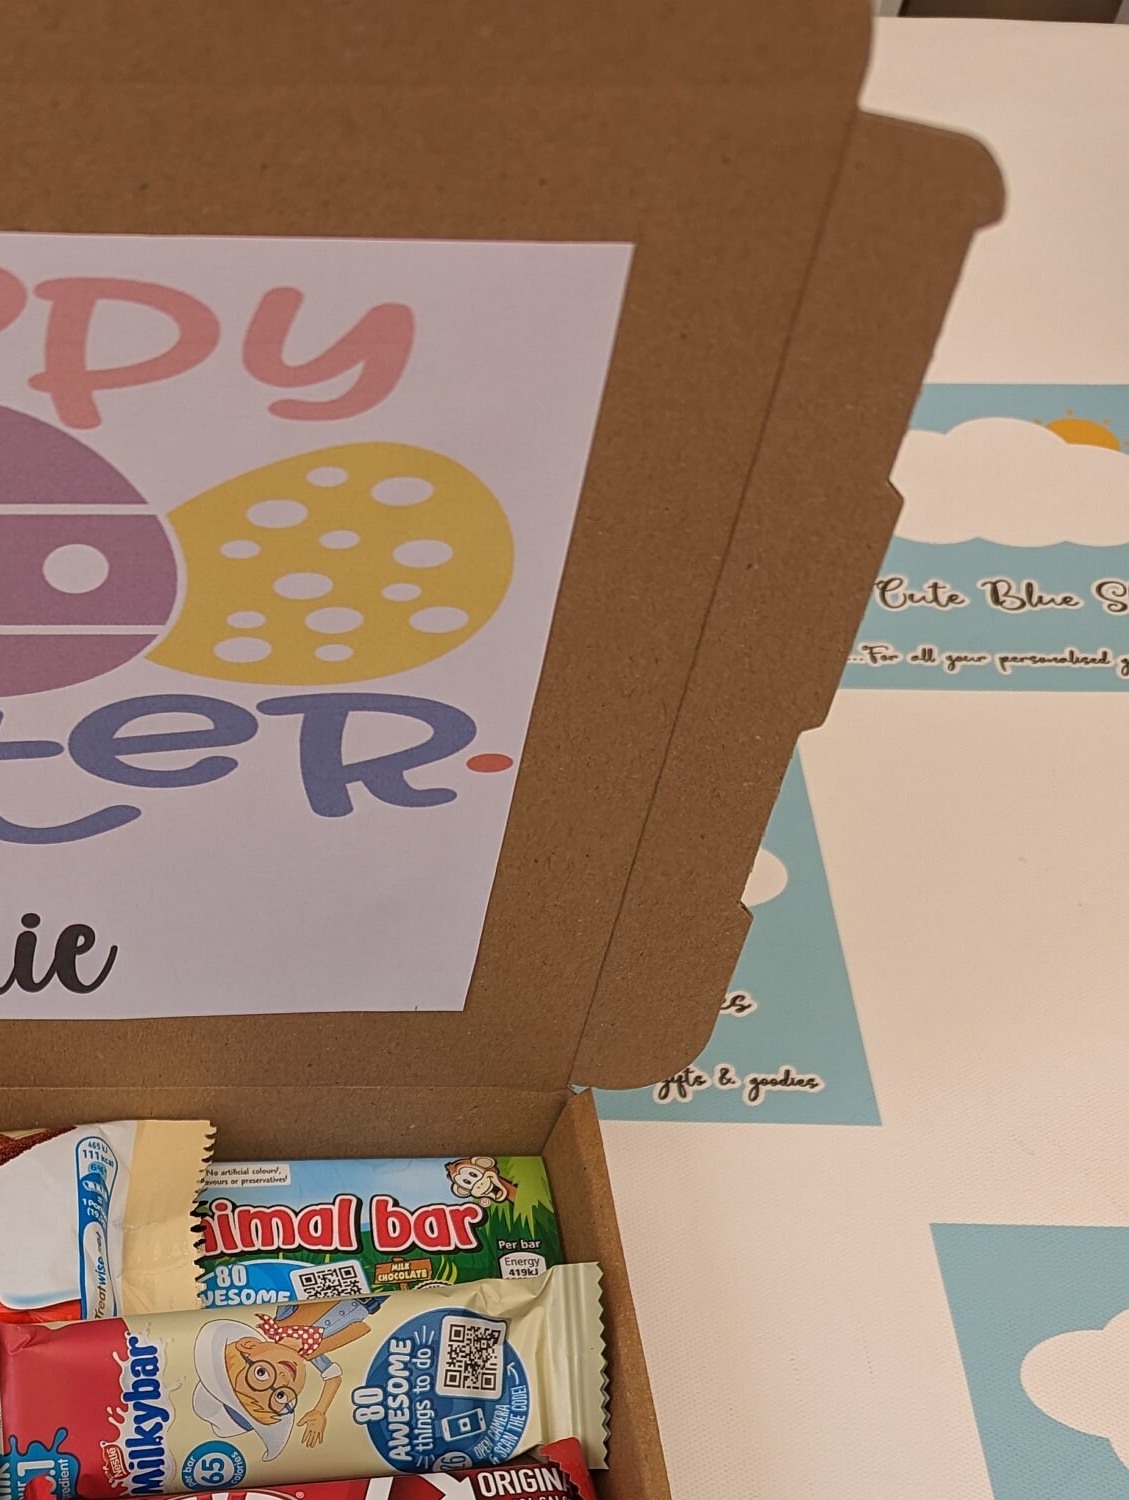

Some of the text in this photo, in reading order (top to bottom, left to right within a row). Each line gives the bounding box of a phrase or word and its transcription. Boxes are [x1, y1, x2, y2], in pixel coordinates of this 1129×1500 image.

[874, 577, 965, 609] Cute
[978, 579, 1081, 611] Blue
[910, 647, 936, 664] all
[945, 654, 987, 671] your
[999, 649, 1110, 674] personalised
[718, 1067, 735, 1085] &
[748, 1069, 819, 1102] goodies
[83, 1149, 99, 1161] 111
[206, 1169, 218, 1177] No
[220, 1168, 249, 1176] artificial
[371, 1196, 482, 1250] bar
[498, 1240, 541, 1249] Per bar
[215, 1264, 247, 1288] 80
[377, 1268, 428, 1281] CHOCOLATE
[390, 1262, 411, 1272] MILK
[505, 1257, 540, 1268] Energy
[353, 1387, 385, 1423] 80
[387, 1339, 413, 1461] AWESOME
[412, 1348, 435, 1452] things to do
[510, 1384, 528, 1411] CODE!
[122, 1336, 170, 1495] Milkybar
[506, 1413, 526, 1433] THE
[474, 1404, 511, 1459] OPEN CAMERA
[494, 1431, 520, 1458] SCAN
[58, 1457, 72, 1498] redient
[183, 1455, 196, 1473] bar
[201, 1457, 225, 1485] 65
[230, 1451, 244, 1485] calories
